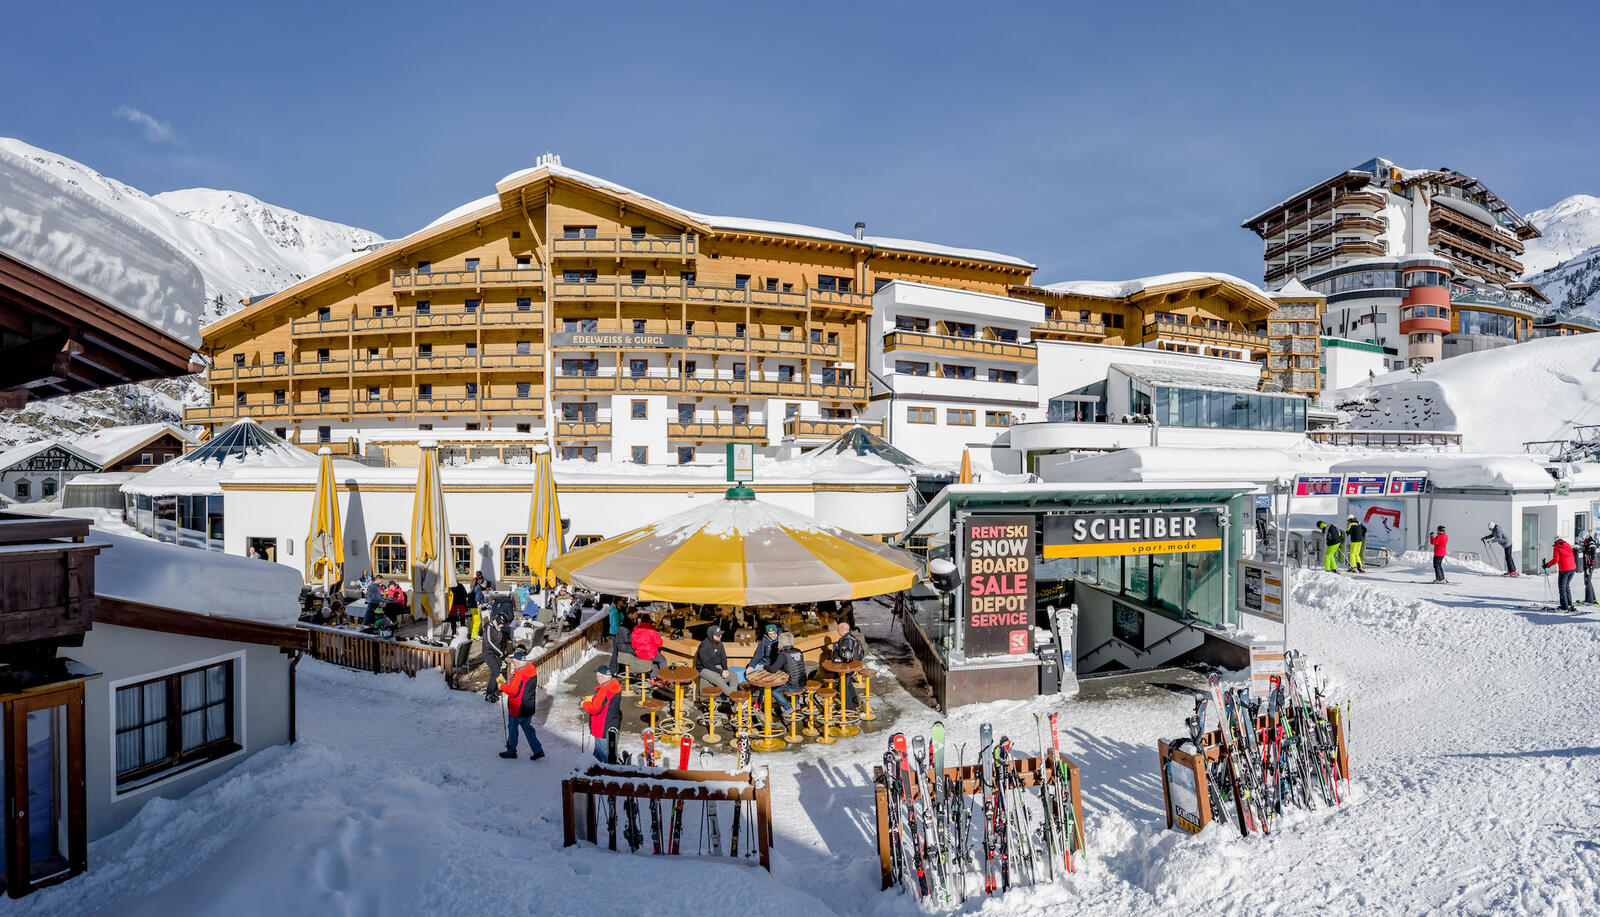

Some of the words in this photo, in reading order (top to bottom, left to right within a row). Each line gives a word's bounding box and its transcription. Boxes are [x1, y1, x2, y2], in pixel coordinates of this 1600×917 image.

[573, 335, 623, 344] EDELWEISS
[625, 336, 632, 344] &
[634, 336, 664, 345] GURGL
[1072, 516, 1197, 541] SCHEIBER
[970, 539, 1028, 557] SNOW
[1132, 541, 1197, 553] sport.mode
[971, 557, 1029, 574] BOARD
[970, 574, 1028, 596] SALE
[971, 595, 1028, 613] DEPOT
[971, 612, 1028, 627] SERVICE
